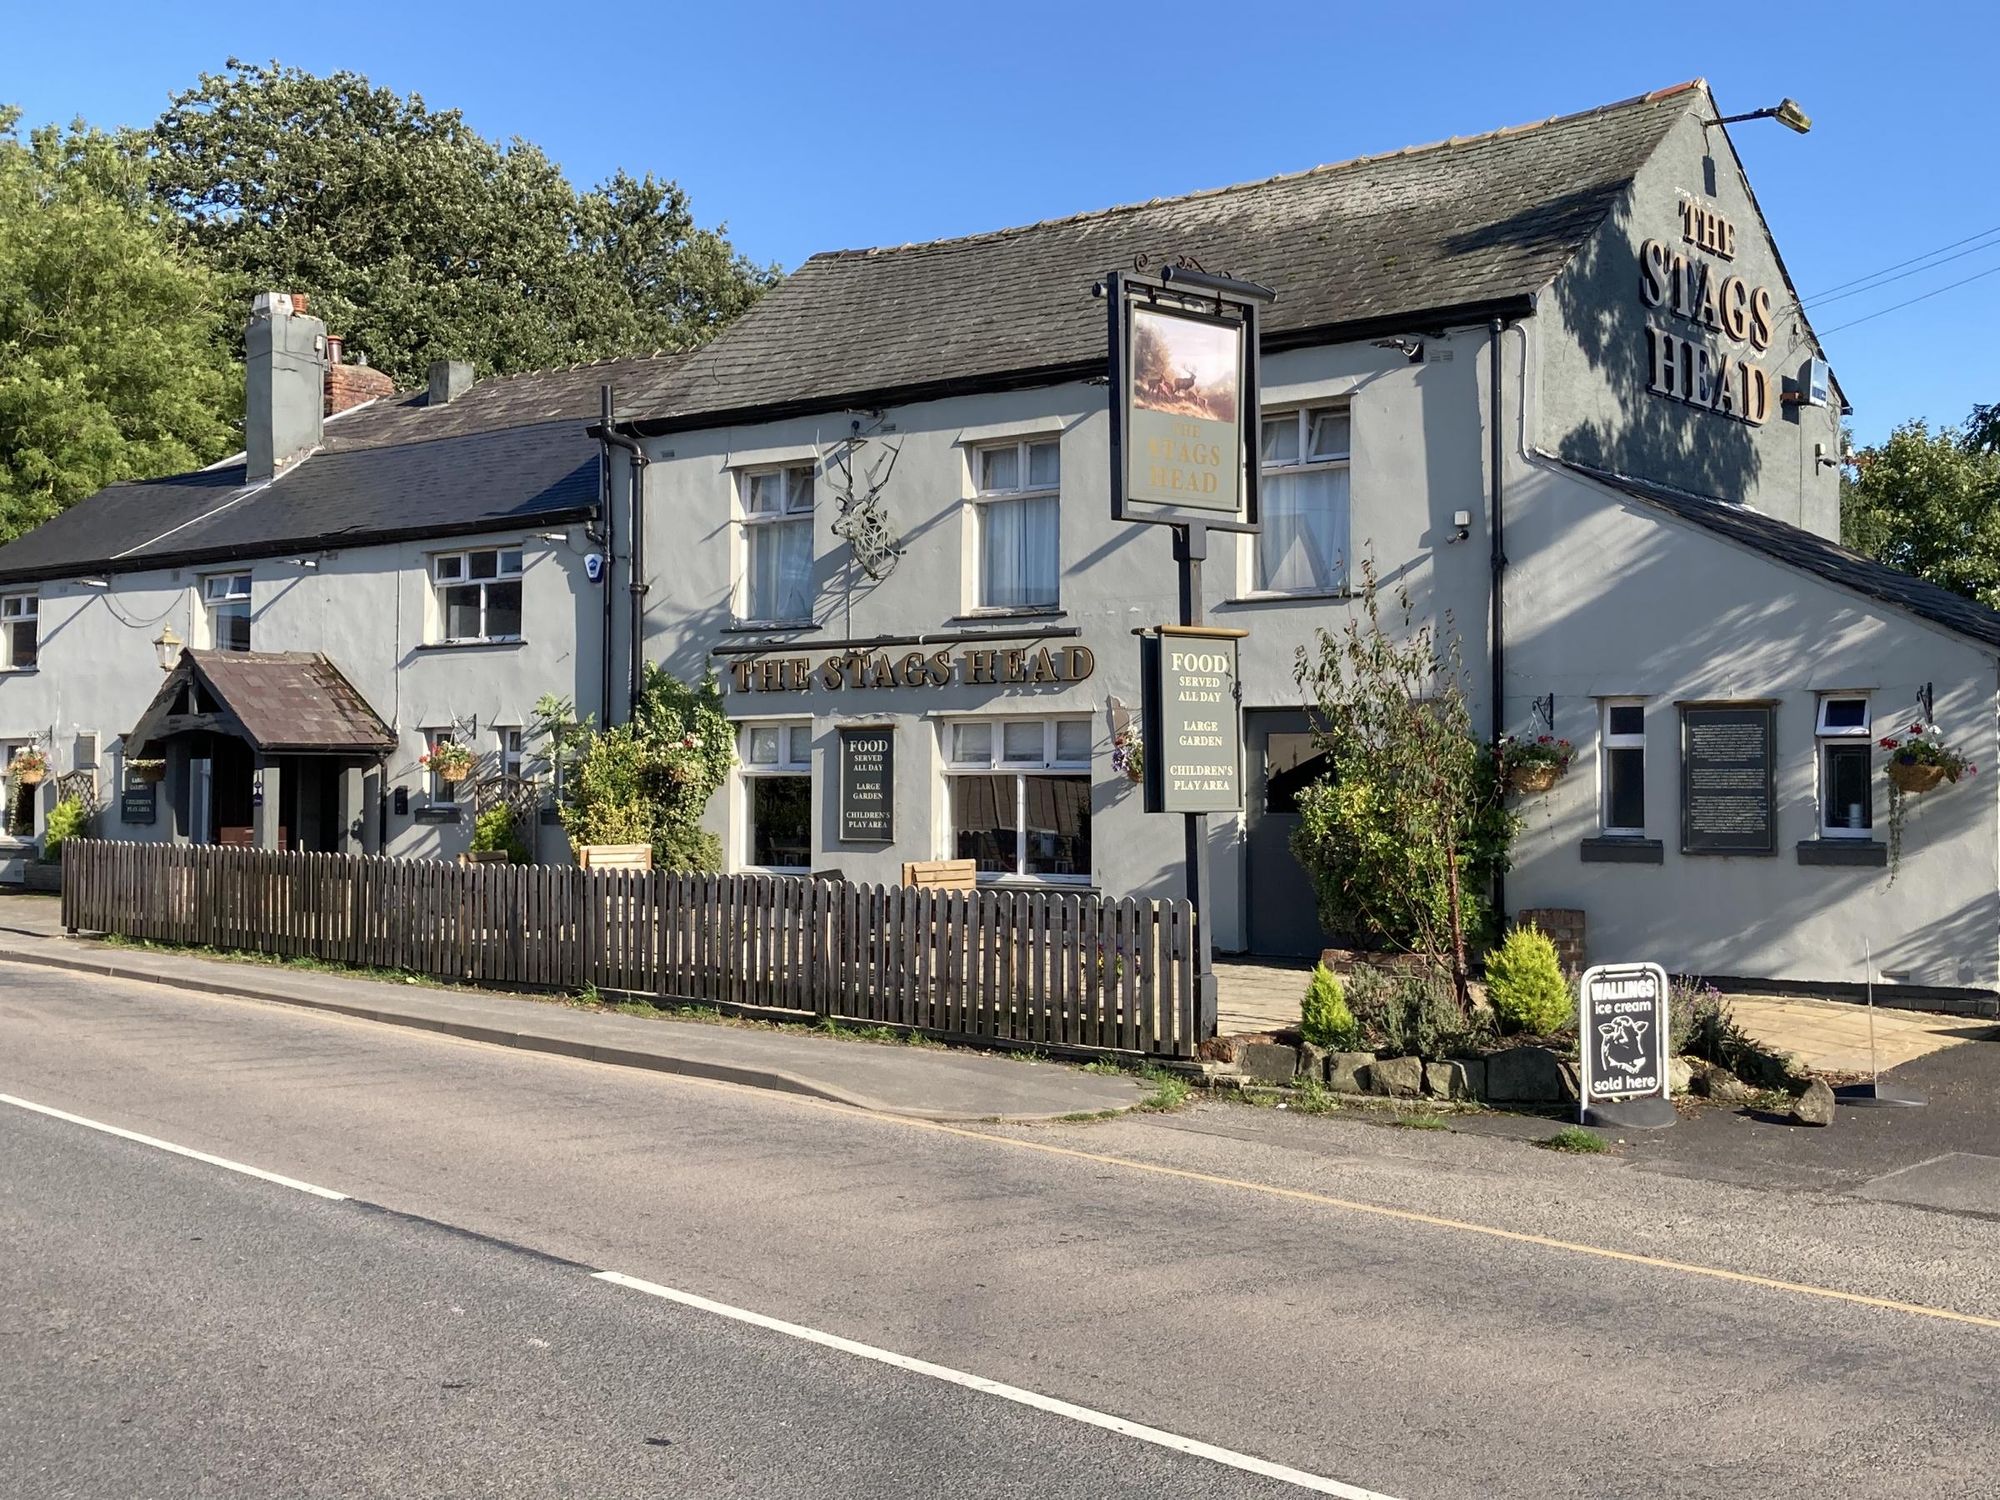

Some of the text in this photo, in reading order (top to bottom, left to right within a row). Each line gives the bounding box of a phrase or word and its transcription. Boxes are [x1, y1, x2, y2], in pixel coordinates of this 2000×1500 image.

[1678, 200, 1736, 263] THE
[1640, 238, 1774, 352] STAGS
[1647, 323, 1774, 427] HEAD
[1148, 437, 1221, 467] STAGS
[1150, 466, 1218, 493] HEAD
[730, 645, 1095, 693] THE STAGS HEAD
[1171, 652, 1228, 673] FOOD
[1179, 675, 1220, 688] SERVED
[1178, 691, 1222, 703] ALL DAY
[1184, 720, 1218, 731] LARGE
[849, 740, 889, 752] FOOD
[1179, 735, 1223, 747] GARDEN
[854, 754, 883, 762] SERVED
[853, 764, 883, 772] ALL DAY
[1169, 765, 1233, 776] CHILDREN'S
[1174, 780, 1230, 791] PLAY AREA
[852, 792, 883, 800] GARDEN
[846, 811, 891, 819] CHILDREN'S
[1591, 979, 1655, 1001] WALLINGS
[1595, 1001, 1651, 1015] ice cream
[1594, 1075, 1656, 1092] sold here
